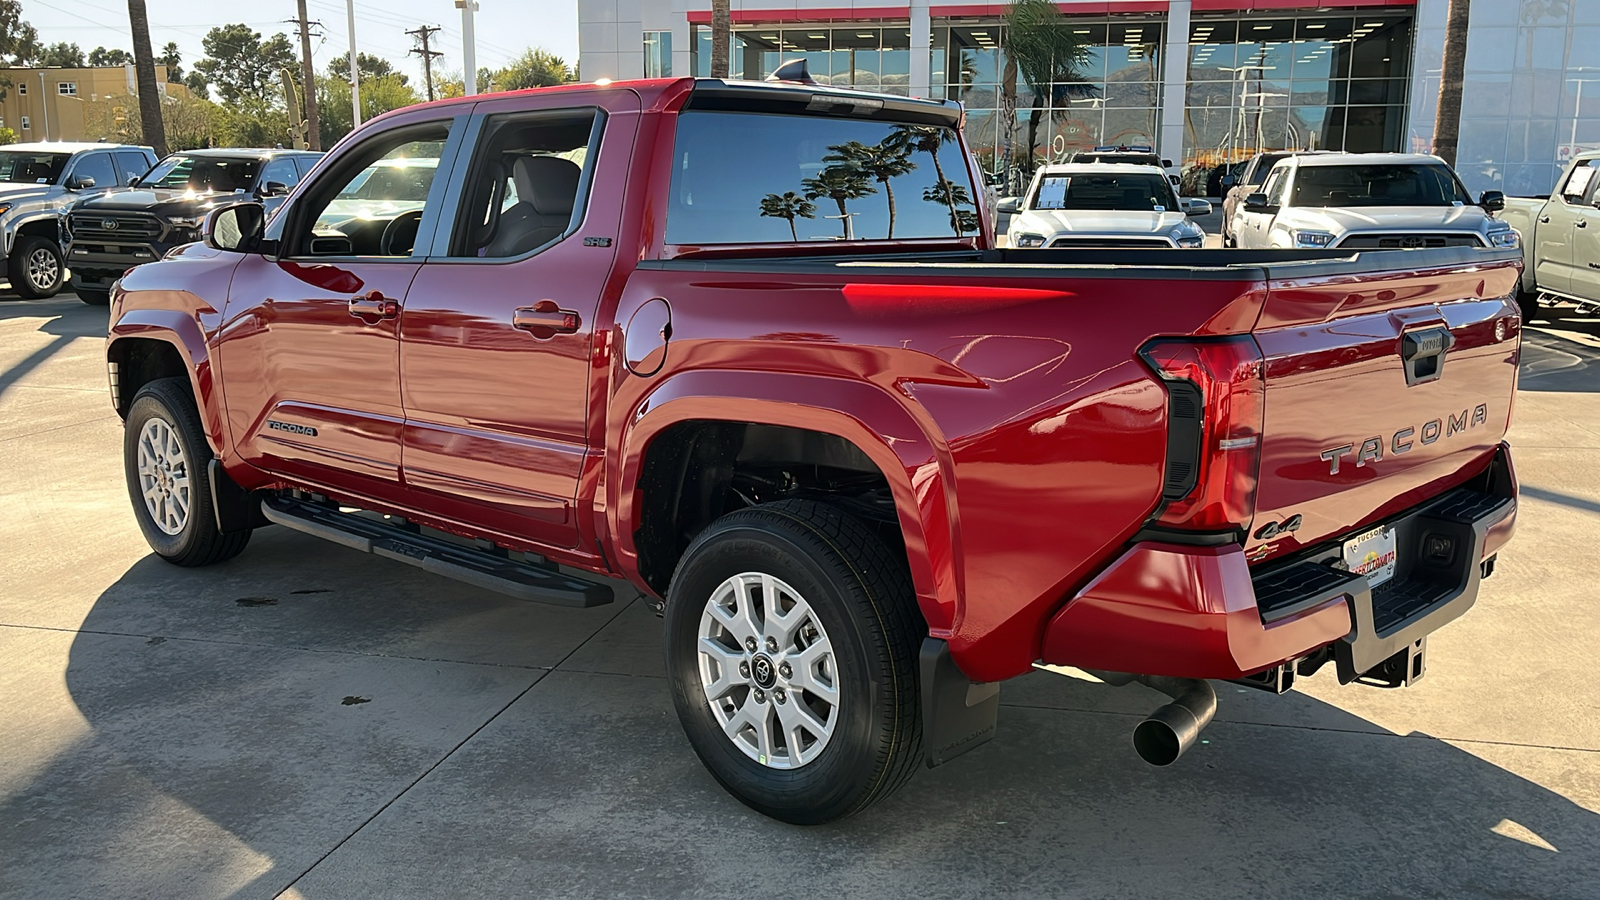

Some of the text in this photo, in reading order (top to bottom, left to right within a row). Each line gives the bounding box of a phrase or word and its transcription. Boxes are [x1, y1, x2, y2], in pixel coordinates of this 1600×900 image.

[266, 420, 314, 436] TACOMA
[1319, 402, 1488, 476] TACOMA
[1357, 527, 1384, 543] TUCSON
